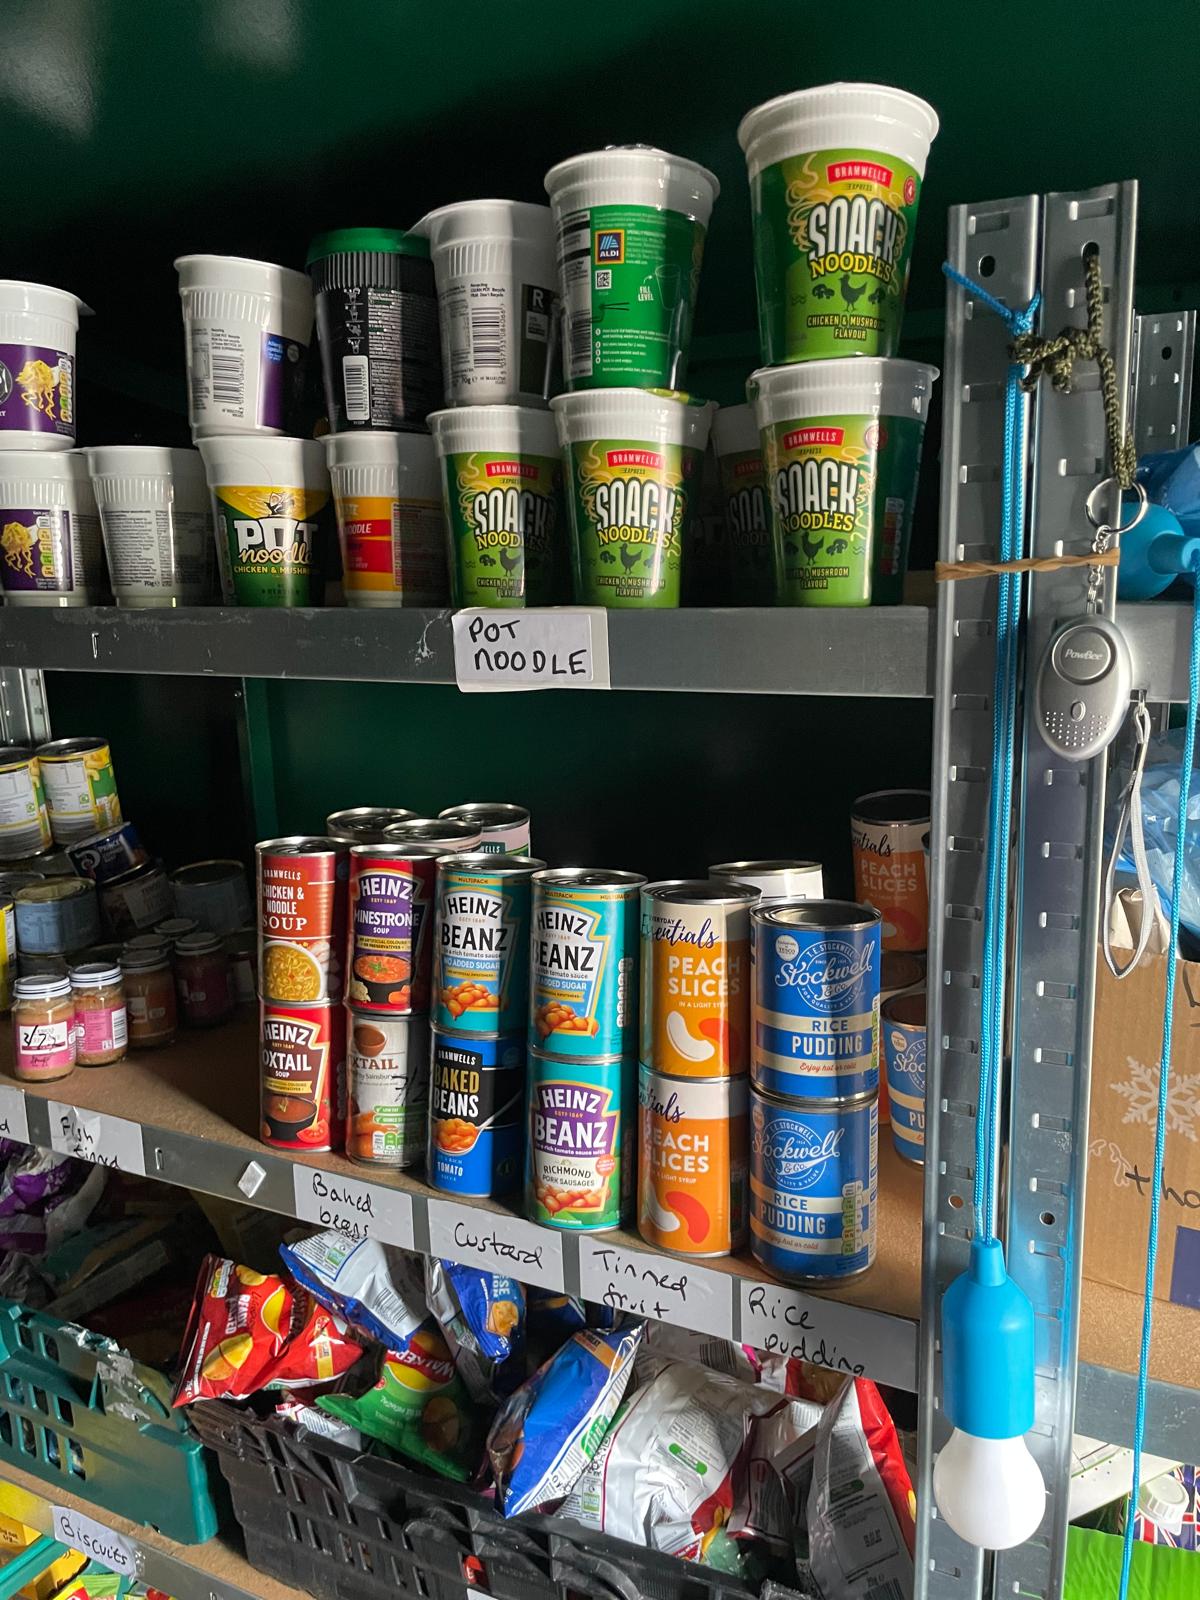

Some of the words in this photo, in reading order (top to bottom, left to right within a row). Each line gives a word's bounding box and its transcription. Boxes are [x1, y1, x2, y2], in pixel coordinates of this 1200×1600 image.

[834, 166, 888, 183] BRAMWELLS
[808, 197, 898, 262] SNACK
[599, 250, 620, 258] ALDI
[810, 254, 892, 284] NOODLES
[807, 315, 840, 327] CHICKEN
[849, 316, 884, 331] MUSHRO
[834, 328, 867, 340] FLAVOUR
[789, 431, 837, 447] BRAMWELLS
[613, 453, 661, 466] BRAMWELLS
[777, 459, 859, 519] SNACK
[474, 488, 548, 538] SNACK
[595, 480, 676, 535] SNACK
[729, 488, 766, 534] SNA
[782, 511, 855, 535] NOODLES
[233, 516, 320, 553] POT
[599, 525, 672, 548] NOODLES
[239, 542, 313, 564] noodle
[234, 566, 268, 574] CHICKEN
[271, 566, 279, 574] &
[280, 566, 309, 575] MUSHR
[811, 567, 850, 577] MUSHROOM
[616, 588, 644, 598] FLAVOUR
[468, 615, 521, 643] POT
[474, 647, 588, 676] NOODLE
[860, 859, 918, 877] PEACH
[263, 883, 294, 900] CHICKEN
[297, 886, 305, 900] &
[360, 877, 413, 901] HEINZ
[457, 876, 489, 885] MULTIPACK
[862, 877, 919, 893] SLICES
[544, 890, 574, 899] MULTIPACK
[266, 900, 298, 915] NOODLE
[354, 908, 420, 928] MINESTRONE
[448, 896, 503, 920] HEINZ
[263, 916, 308, 931] SOUP
[373, 926, 390, 934] SOUP
[537, 911, 588, 937] HEINZ
[441, 922, 508, 952] BEANZ
[453, 959, 475, 970] ADDED
[463, 951, 484, 959] tomato
[533, 940, 595, 972] BEANZ
[668, 955, 741, 977] PEACH
[774, 940, 873, 987] Stockwell
[549, 969, 570, 978] tomato
[570, 971, 588, 979] sauce
[561, 980, 587, 990] SUGAR
[668, 977, 742, 998] SLICES
[263, 1022, 310, 1046] HEINZ
[812, 1019, 849, 1032] RICE
[792, 1034, 863, 1056] PUDDING
[262, 1048, 312, 1072] OXTAIL
[352, 1056, 399, 1070] XTAIL
[800, 1062, 821, 1073] Enjoy
[275, 1070, 290, 1078] SOUP
[434, 1063, 480, 1094] BAKED
[434, 1089, 480, 1118] BEANS
[542, 1087, 601, 1114] HEINZ
[60, 1116, 94, 1145] Fish
[534, 1115, 609, 1149] BEANZ
[653, 1127, 709, 1153] EACH
[780, 1121, 814, 1140] STOCKWELL
[73, 1146, 120, 1169] tinned
[554, 1147, 575, 1155] tomato
[652, 1146, 709, 1173] LICES
[437, 1161, 463, 1177] TOMATO
[543, 1165, 592, 1179] RICHMOND
[783, 1162, 792, 1173] &
[804, 1169, 820, 1184] VALUE
[542, 1174, 559, 1185] PORK
[560, 1178, 594, 1187] SAUSAGES
[678, 1176, 697, 1184] SYRUP
[312, 1172, 375, 1218] Baked
[774, 1193, 808, 1211] RICE
[761, 1205, 827, 1235] PUDDING
[454, 1222, 543, 1270] Custard
[803, 1242, 819, 1250] cold
[592, 1249, 688, 1301] Tinned
[602, 1282, 671, 1319] fruit
[748, 1286, 816, 1330] Rice
[764, 1333, 866, 1377] pudding
[60, 1515, 129, 1566] Biscuits
